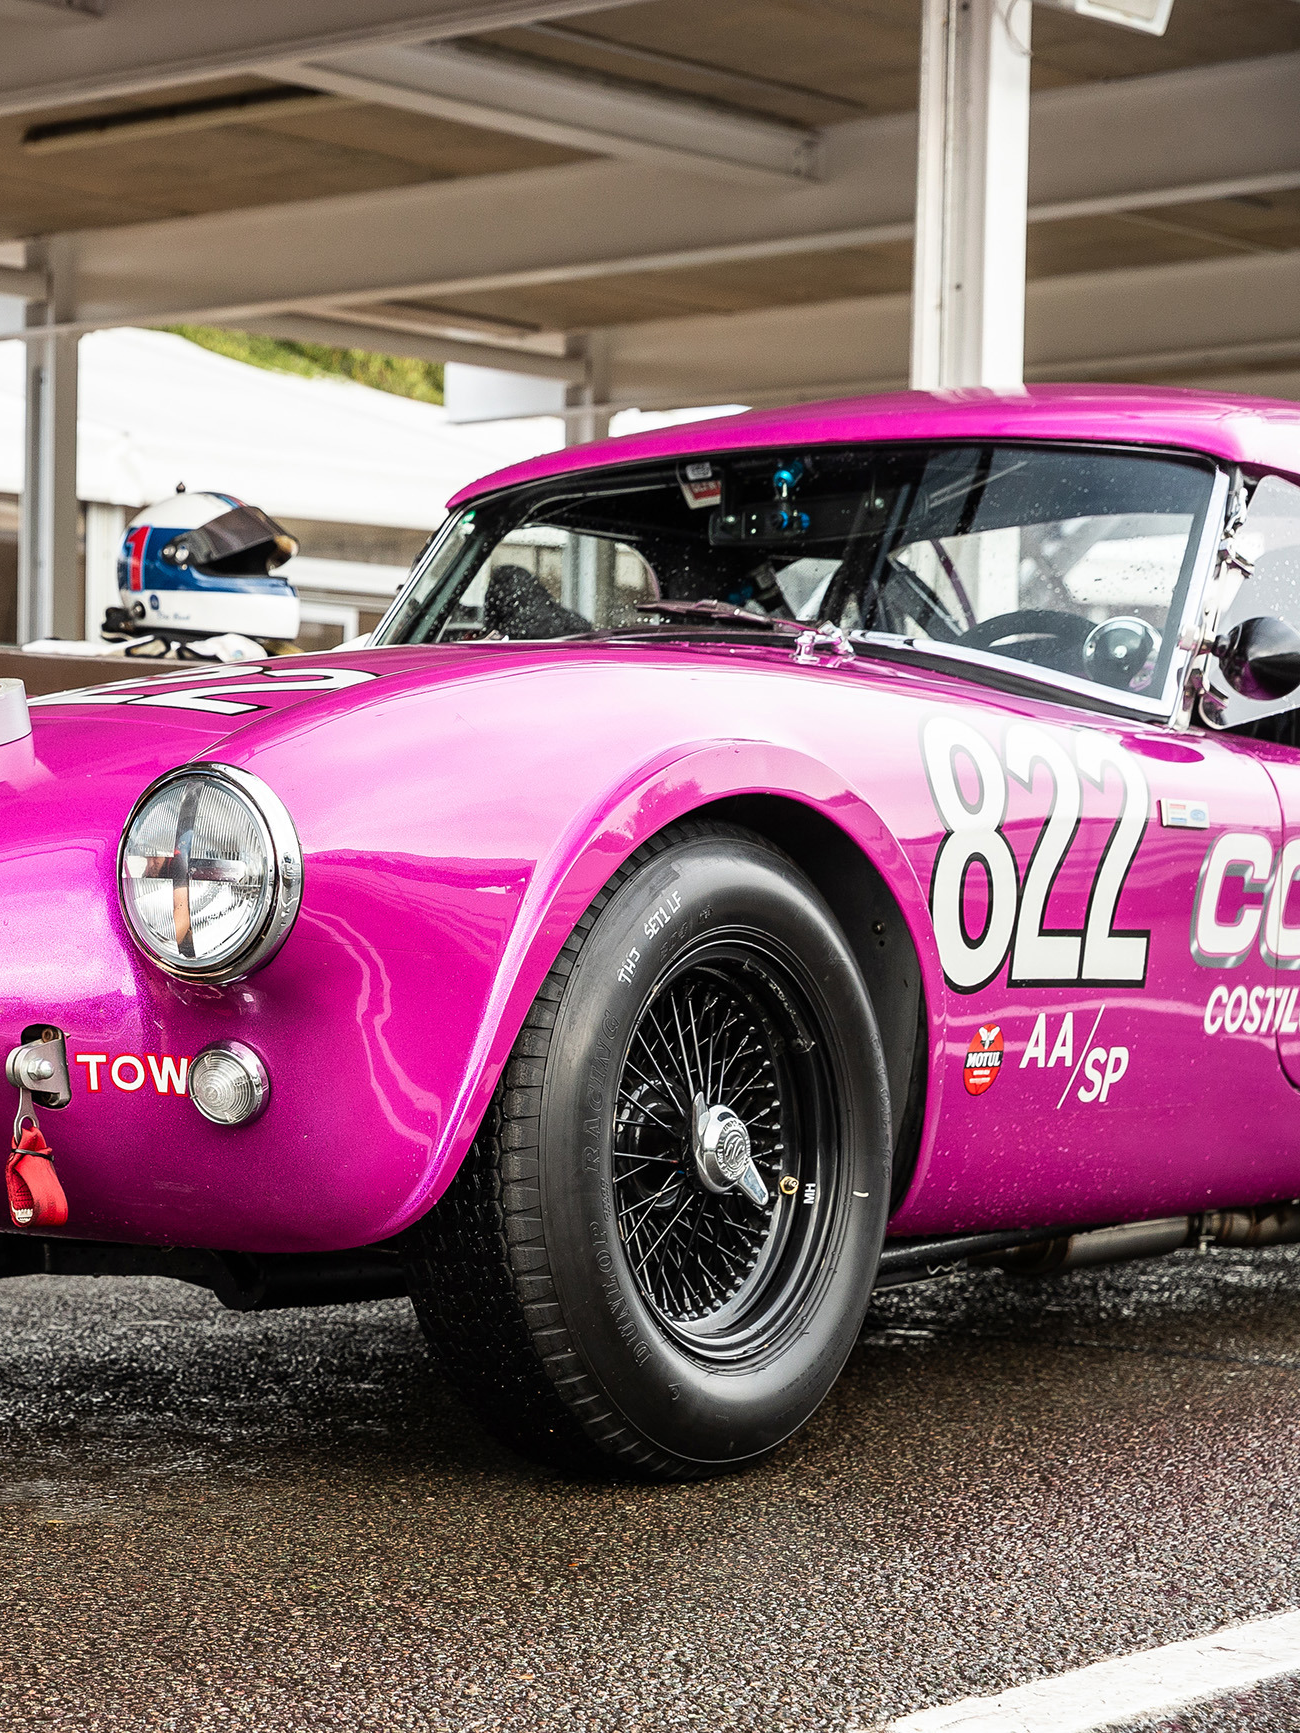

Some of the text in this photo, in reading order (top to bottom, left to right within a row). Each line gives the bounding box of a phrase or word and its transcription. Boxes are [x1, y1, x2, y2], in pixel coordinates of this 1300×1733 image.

[125, 525, 151, 591] 1
[919, 711, 1151, 995] 822
[1203, 985, 1300, 1035] COSTIL
[75, 1052, 191, 1097] TOW
[965, 1051, 1002, 1068] MOTUL
[584, 1008, 653, 1368] DUNLOP RACING
[803, 1182, 817, 1205] MH
